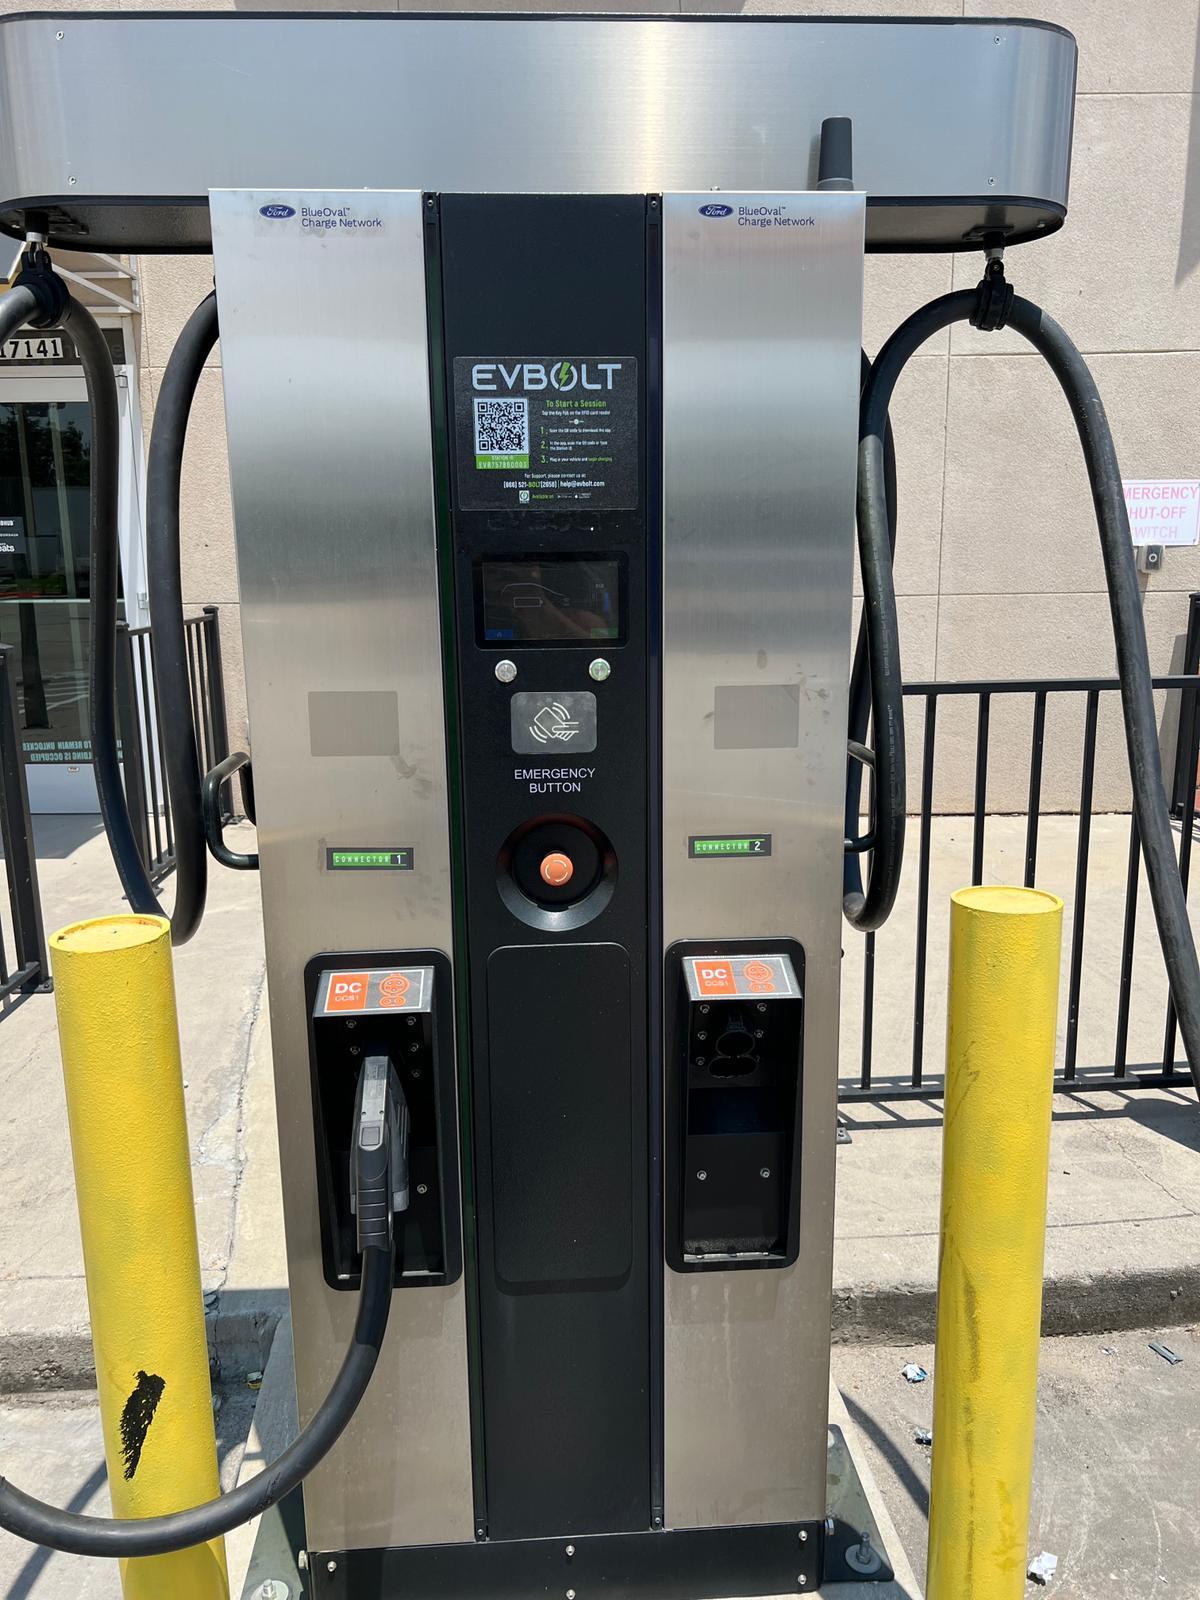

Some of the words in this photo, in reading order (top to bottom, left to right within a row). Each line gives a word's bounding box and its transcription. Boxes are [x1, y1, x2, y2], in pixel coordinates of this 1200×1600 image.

[266, 205, 289, 217] Ford
[705, 204, 727, 216] Ford
[301, 218, 337, 229] Charge
[339, 218, 382, 228] Network
[738, 216, 772, 227] Charge
[774, 216, 815, 226] Network
[471, 361, 622, 392] EVBOLT
[546, 400, 554, 408] To
[555, 400, 573, 408] Start
[580, 400, 607, 408] Session
[560, 480, 605, 489] help@evbolt.com
[1123, 486, 1199, 500] MERGENCY
[1129, 506, 1187, 520] HUT-OFF
[1135, 526, 1178, 539] WITCH
[514, 768, 596, 780] EMERGENCY
[529, 782, 581, 793] BUTTON
[696, 842, 748, 851] CONNECTOR
[754, 841, 761, 851] 2
[335, 855, 389, 863] CONNECTOR
[396, 854, 401, 865] 1
[702, 968, 728, 979] DC
[335, 982, 362, 994] DC
